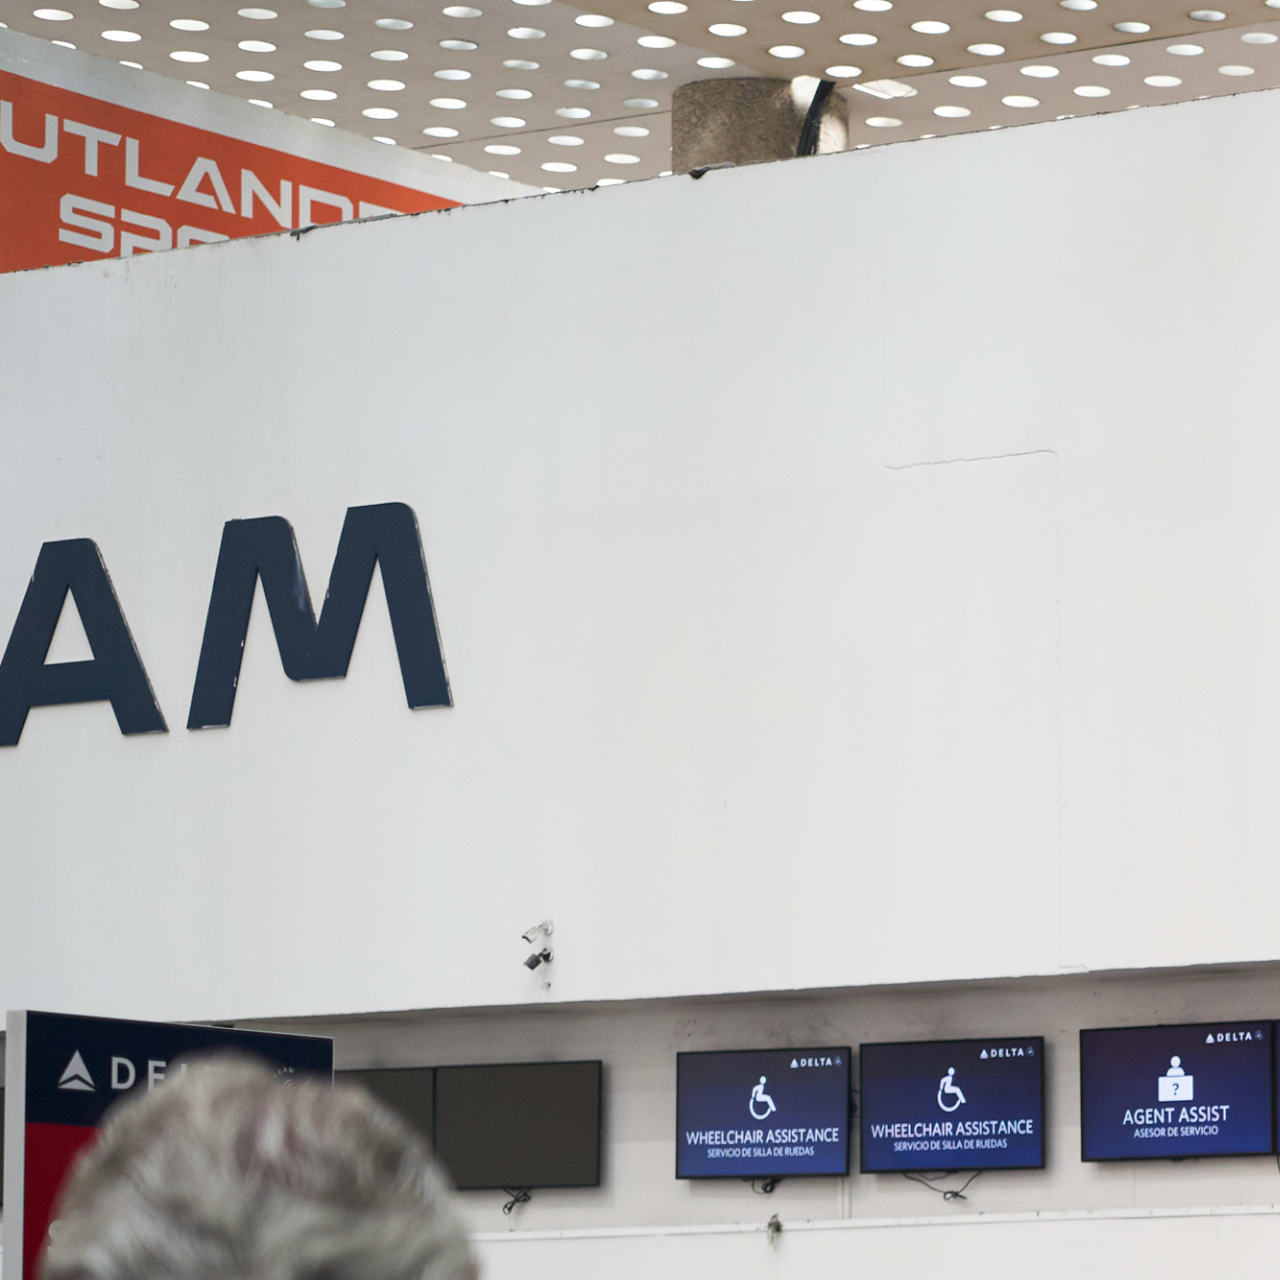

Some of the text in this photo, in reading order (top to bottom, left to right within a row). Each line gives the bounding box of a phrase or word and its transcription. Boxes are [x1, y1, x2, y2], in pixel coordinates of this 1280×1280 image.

[0, 102, 406, 230] UTLAND
[0, 501, 454, 747] AM
[1216, 1031, 1252, 1042] DELTA
[991, 1048, 1024, 1058] DELTA
[800, 1058, 832, 1067] DELTA
[1123, 1105, 1230, 1125] AGENT ASSIST
[686, 1127, 839, 1145] WHEELCHAIR ASSISTANCE
[871, 1119, 1033, 1138] WHEELCHAIR ASSISTANCE
[1134, 1125, 1218, 1138] ASESOR DE SERVICIO
